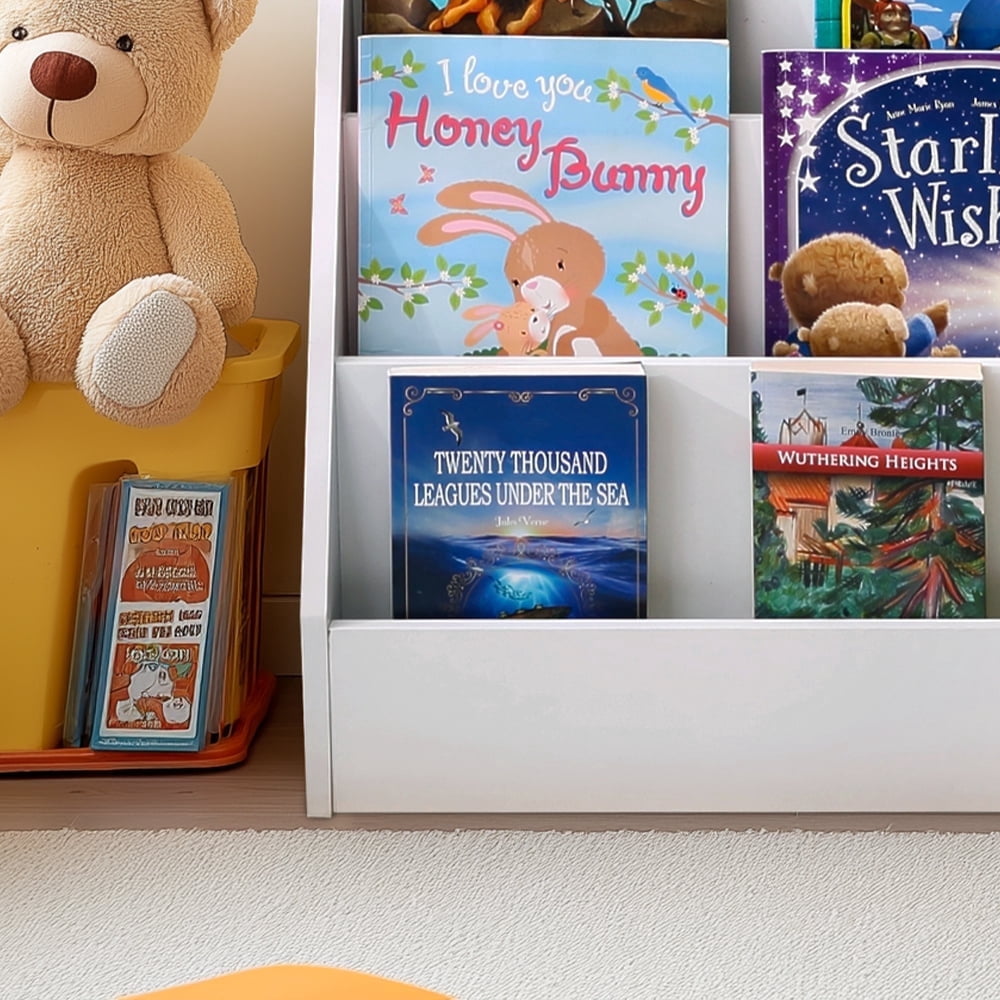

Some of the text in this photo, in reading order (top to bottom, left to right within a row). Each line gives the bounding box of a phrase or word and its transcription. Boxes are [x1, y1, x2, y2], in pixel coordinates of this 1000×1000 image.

[437, 55, 593, 112] I love you
[971, 97, 997, 109] James
[385, 91, 543, 171] Honey
[542, 137, 706, 218] Bunny
[434, 451, 608, 475] TWENTY THOUSAND
[777, 450, 958, 471] WUTHERING HEIGHTS
[414, 483, 630, 506] LEAGUES UNDER THE SEA
